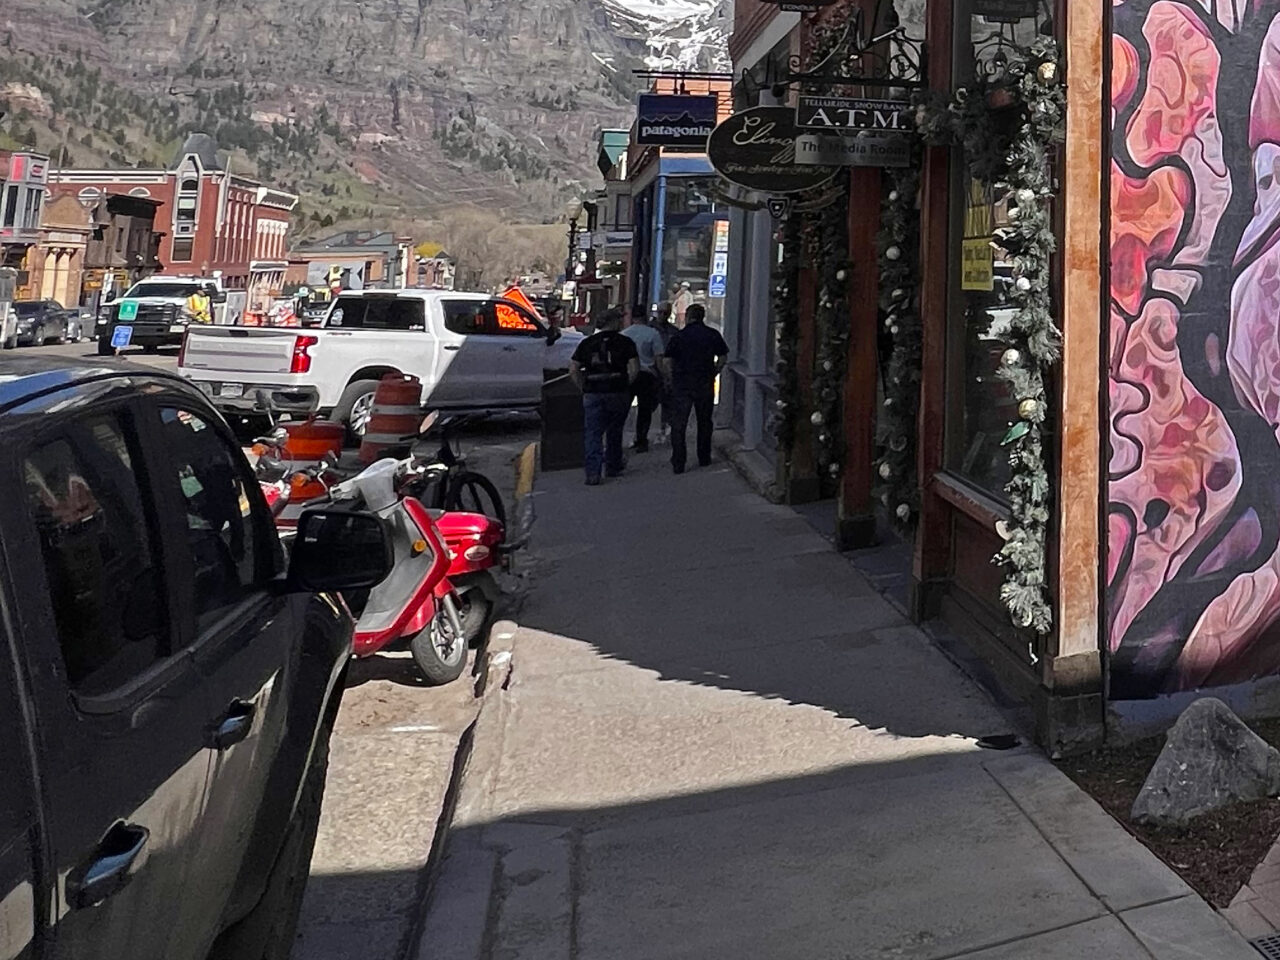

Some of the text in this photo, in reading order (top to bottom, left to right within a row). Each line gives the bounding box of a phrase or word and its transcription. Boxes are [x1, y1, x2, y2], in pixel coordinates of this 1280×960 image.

[806, 108, 907, 129] A.T.M.
[641, 125, 713, 137] patagonia
[801, 142, 824, 153] The
[829, 143, 866, 154] Media
